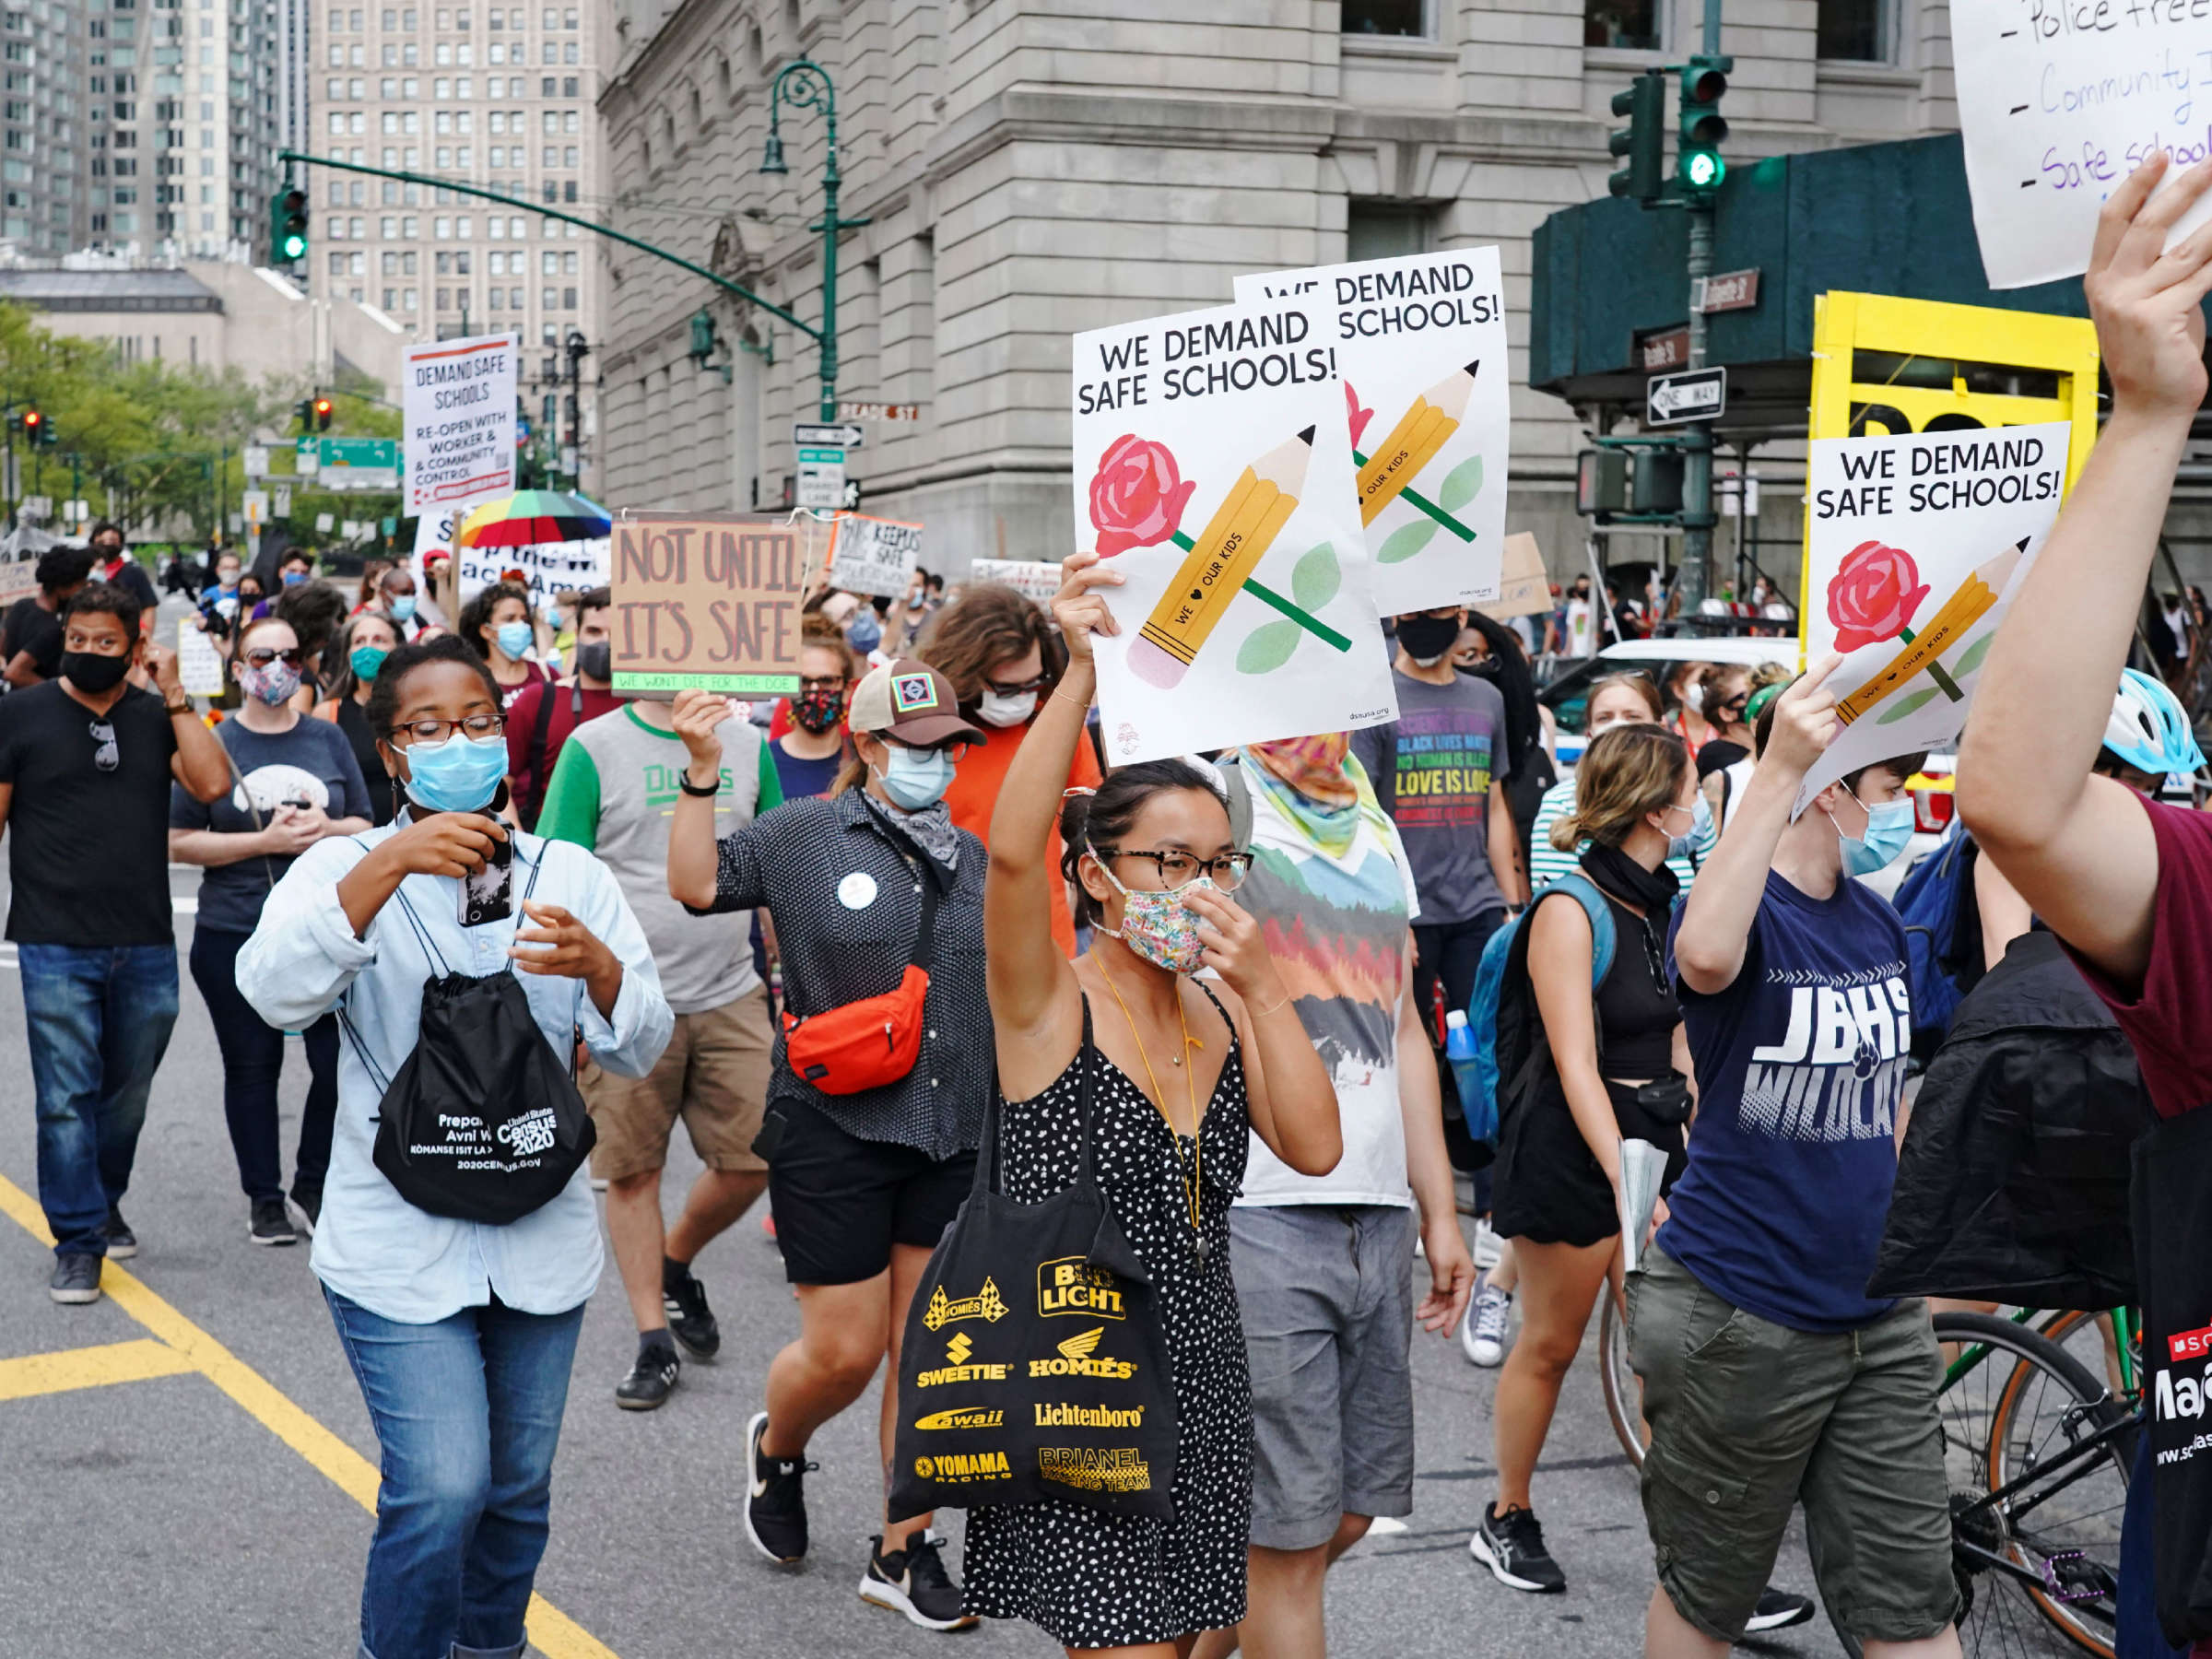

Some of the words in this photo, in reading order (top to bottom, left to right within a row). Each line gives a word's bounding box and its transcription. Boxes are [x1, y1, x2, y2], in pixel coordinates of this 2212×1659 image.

[2041, 47, 2193, 125] Community
[2041, 141, 2117, 189] Safe
[1336, 264, 1474, 305] DEMAND
[1339, 295, 1500, 339] SCHOOLS!
[1100, 335, 1149, 372] WE
[1165, 312, 1309, 362] DEMAND
[417, 361, 472, 387] DEMAND
[475, 355, 505, 376] SAFE
[1079, 374, 1148, 415] SAFE
[1163, 347, 1338, 401] SCHOOLS!
[435, 382, 489, 409] SCHOOLS
[1694, 385, 1714, 402] WAY
[417, 419, 472, 440] RE-OPEN
[475, 411, 507, 428] WITH
[429, 433, 483, 453] WORKER
[487, 429, 496, 442] &
[416, 461, 424, 472] &
[428, 445, 496, 470] COMMUNITY
[1367, 471, 1388, 496] OUR
[1385, 449, 1409, 473] KIDS
[1841, 449, 1896, 481] WE
[1912, 438, 2044, 477] DEMAND
[416, 467, 470, 487] CONTROL
[1817, 486, 1894, 519] SAFE
[1909, 471, 2061, 512] SCHOOLS!
[620, 527, 696, 584] NOT
[703, 530, 802, 593] UNTIL
[1174, 605, 1194, 625] WE
[1202, 560, 1225, 586] OUR
[1219, 531, 1243, 560] KIDS
[618, 600, 694, 663] IT'S
[708, 600, 796, 663] SAFE
[1863, 685, 1881, 700] WE
[1902, 650, 1924, 670] OUR
[1927, 625, 1949, 649] KIDS
[619, 675, 638, 688] WE
[684, 676, 703, 688] DIE
[712, 677, 731, 688] FOR
[738, 677, 759, 689] THE
[765, 677, 790, 690] DOE
[1395, 770, 1443, 796] LOVE
[1445, 770, 1463, 794] IS
[1752, 977, 1911, 1065] JBHS
[445, 1129, 477, 1142] Avni
[512, 1130, 555, 1157] 2020
[497, 1115, 557, 1144] Census
[455, 1146, 472, 1155] ISIT
[474, 1146, 486, 1156] LA
[934, 1451, 1010, 1476] YOMAMA
[1039, 1447, 1148, 1469] BRIANEL
[1106, 1476, 1151, 1492] TEAM
